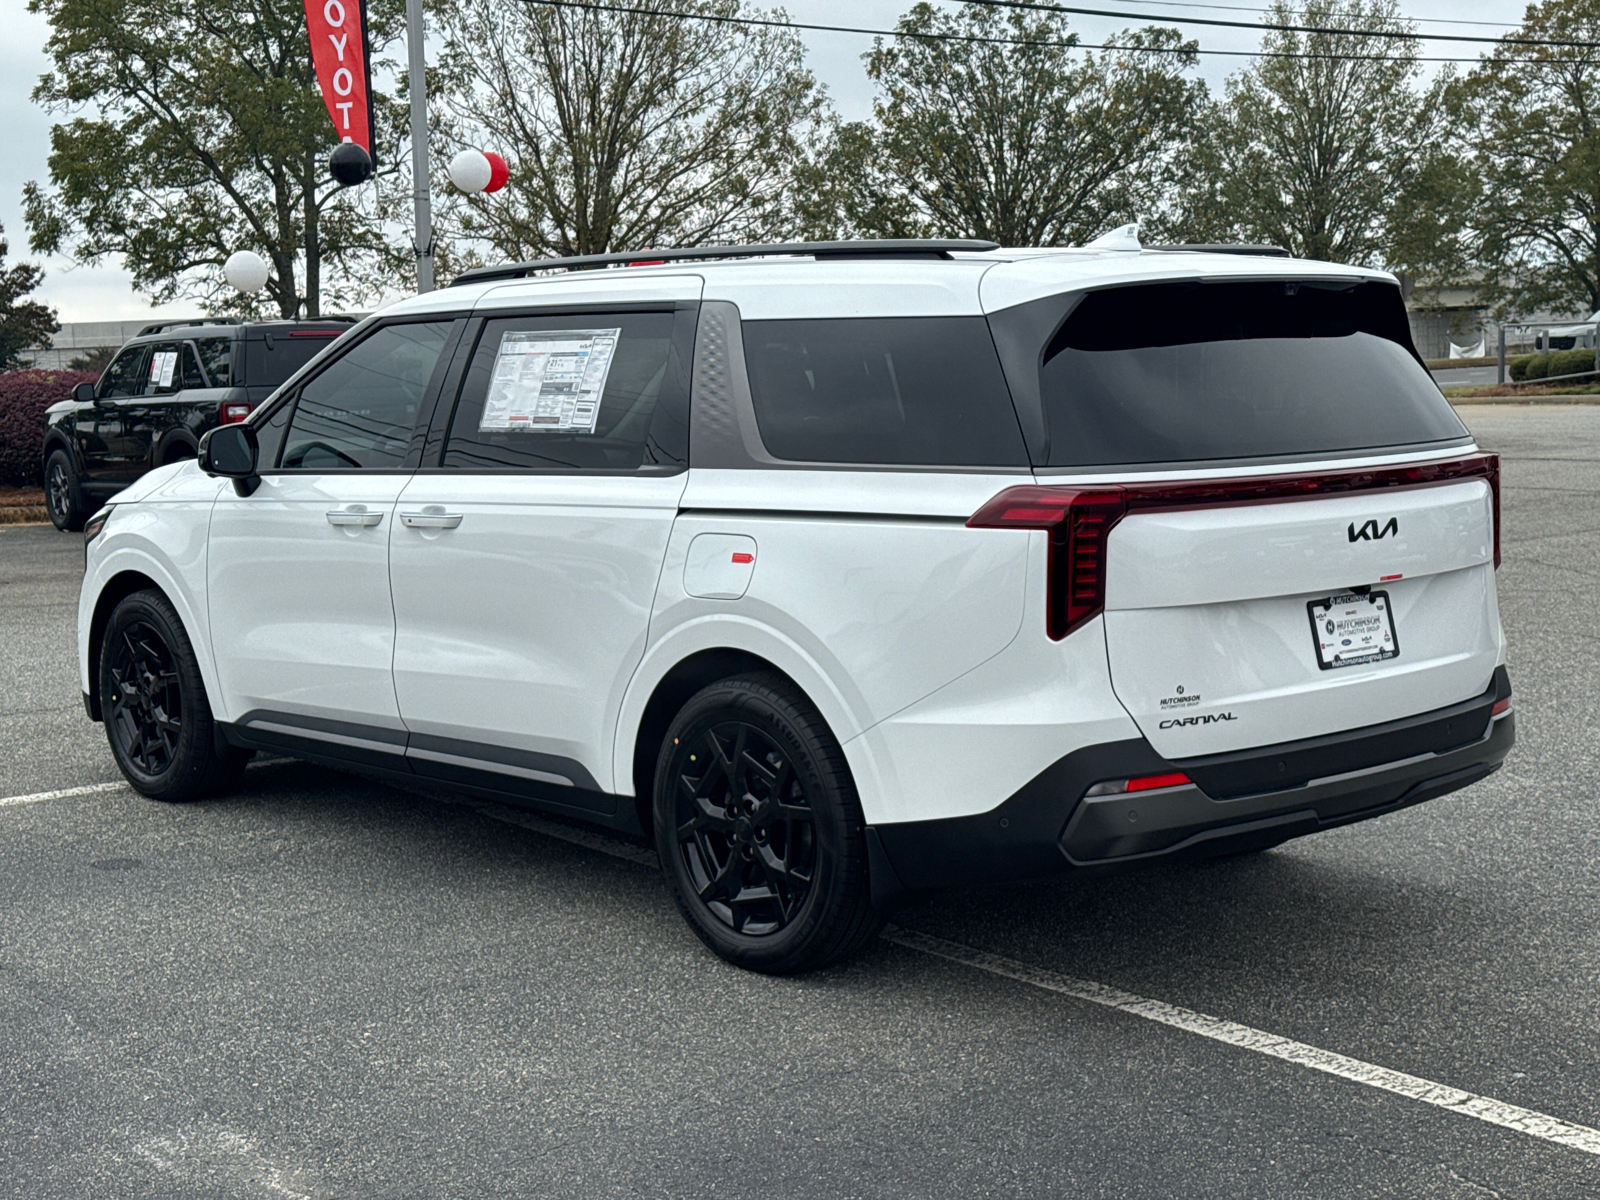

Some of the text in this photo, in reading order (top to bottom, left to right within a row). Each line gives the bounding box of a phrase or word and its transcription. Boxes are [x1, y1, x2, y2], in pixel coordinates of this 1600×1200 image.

[1347, 517, 1398, 542] KIA
[1336, 615, 1381, 631] HUTCHINSON
[1338, 625, 1380, 637] AUTOMOTIVE GROUP
[1160, 694, 1201, 705] HUTCHINSON
[1159, 712, 1238, 729] CARNIVAL
